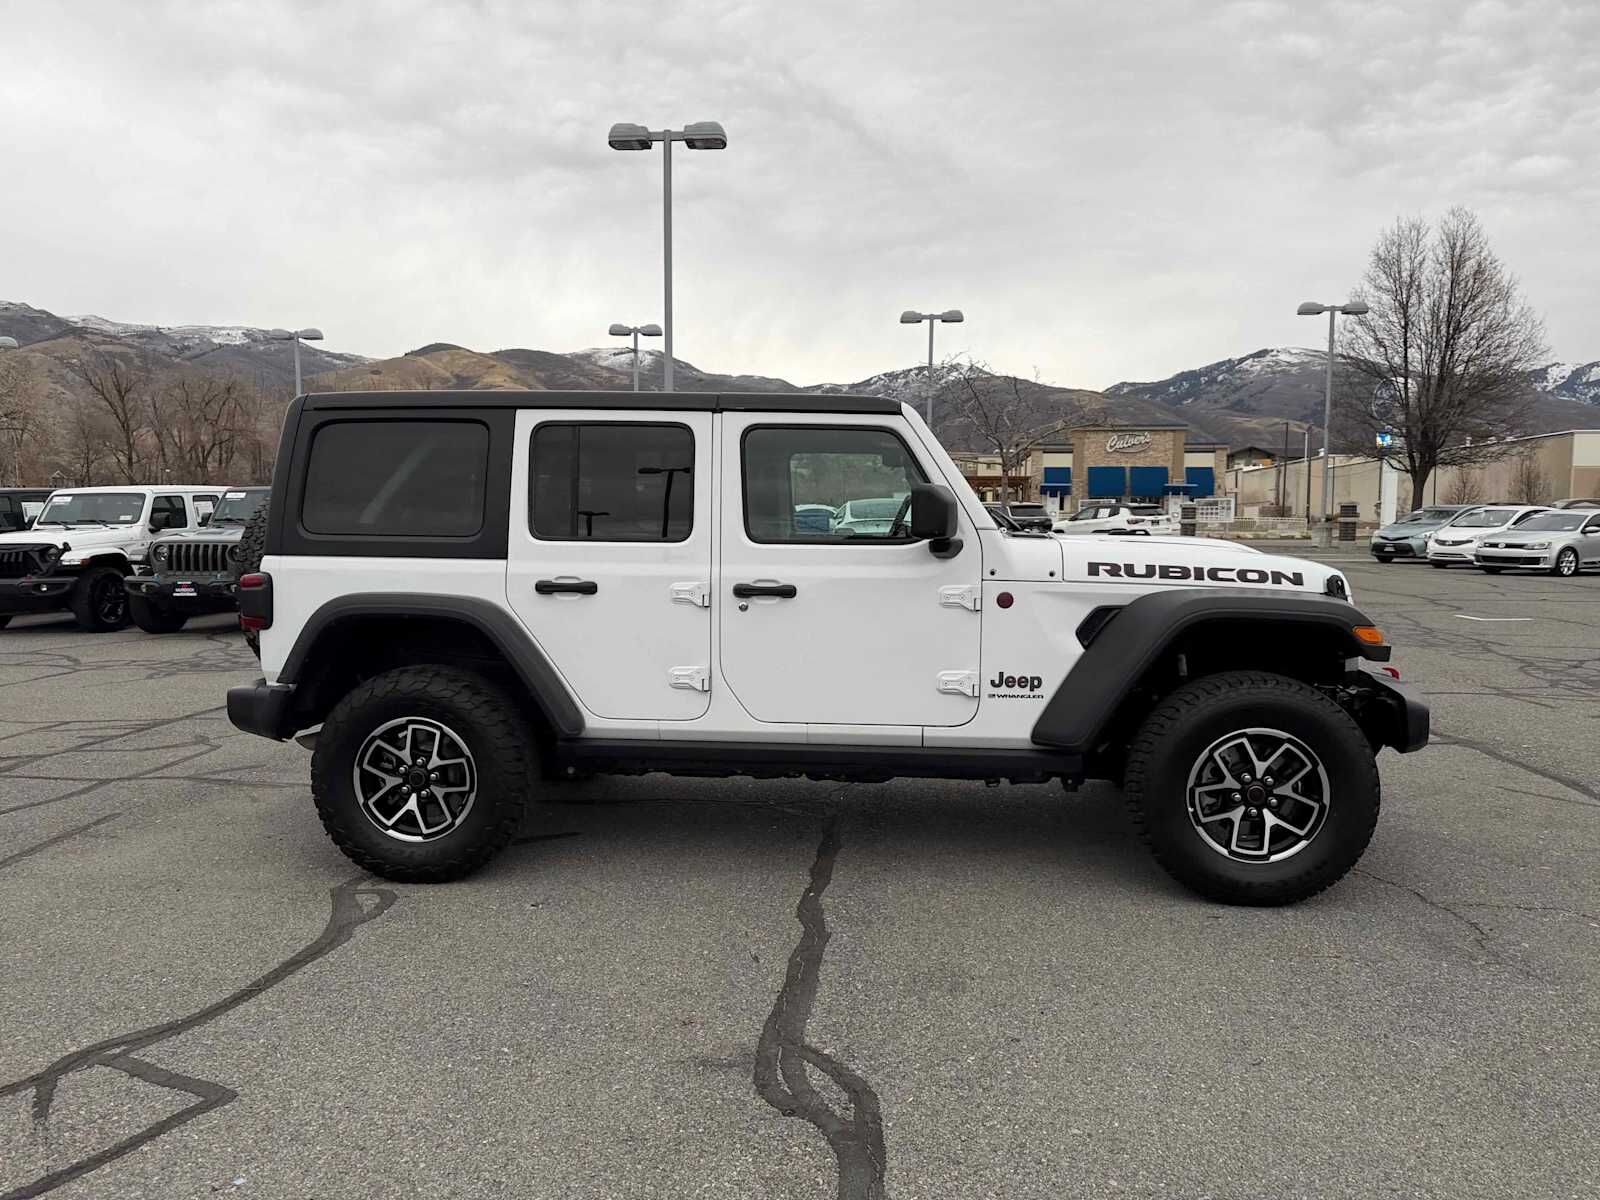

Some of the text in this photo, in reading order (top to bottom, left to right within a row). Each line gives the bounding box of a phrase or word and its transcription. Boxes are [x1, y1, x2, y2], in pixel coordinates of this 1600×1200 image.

[1106, 431, 1152, 452] Culver's
[1087, 562, 1304, 586] RUBICON
[990, 671, 1043, 692] Jeep
